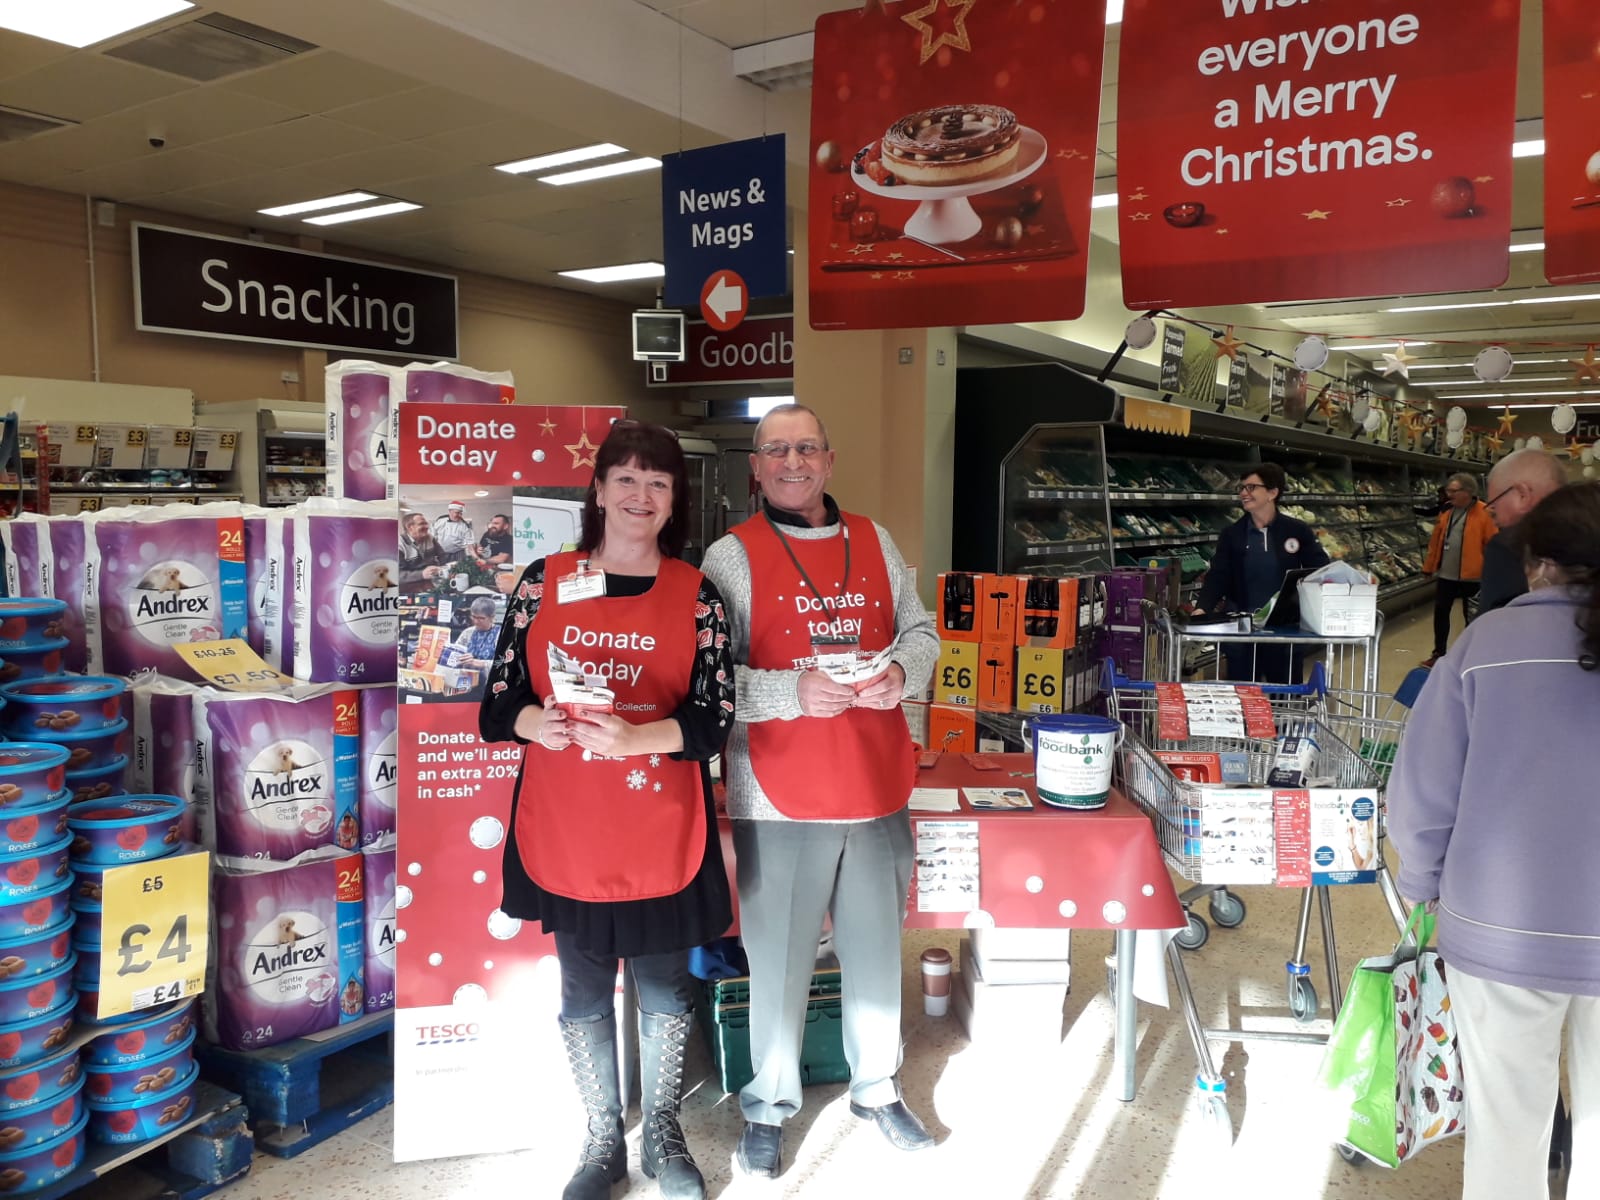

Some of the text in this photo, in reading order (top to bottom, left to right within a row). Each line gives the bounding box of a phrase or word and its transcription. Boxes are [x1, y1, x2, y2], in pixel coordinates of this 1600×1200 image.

[1197, 13, 1420, 75] everyone
[1214, 73, 1398, 129] a Merry
[1180, 130, 1434, 186] Christmas.
[679, 177, 766, 215] News &
[691, 221, 754, 249] Mags
[201, 258, 415, 346] Snacking
[77, 426, 95, 439] £3
[128, 430, 145, 442] £3
[328, 412, 336, 441] Andrex
[417, 415, 517, 440] Donate
[175, 431, 191, 443] £3
[220, 434, 235, 445] £3
[418, 445, 498, 473] today
[80, 499, 97, 511] £3
[220, 530, 243, 547] 24
[137, 593, 209, 617] Andrex
[795, 591, 866, 613] Donate
[808, 616, 862, 637] today
[562, 625, 656, 651] Donate
[350, 662, 365, 674] 24
[942, 666, 972, 689] £6
[1024, 673, 1056, 697] £6
[615, 702, 657, 712] Collection
[955, 696, 967, 704] £6
[1039, 704, 1052, 713] £6
[335, 702, 358, 722] 24
[418, 731, 475, 745] Donate
[1039, 737, 1104, 755] foodbank
[196, 739, 204, 776] Andrex
[417, 747, 521, 763] and we'll add
[417, 764, 519, 781] an extra 20%
[251, 775, 322, 800] Andrex
[417, 785, 432, 799] in
[118, 851, 146, 860] ROSES
[142, 875, 164, 892] £5
[338, 867, 361, 888] 24
[116, 914, 192, 977] £4
[252, 942, 326, 975] Andrex
[152, 981, 181, 1004] £4
[379, 990, 394, 1004] 24
[255, 1024, 273, 1039] 24
[415, 1022, 480, 1040] TESCO
[118, 1053, 146, 1063] ROSES
[111, 1132, 137, 1142] ROSES
